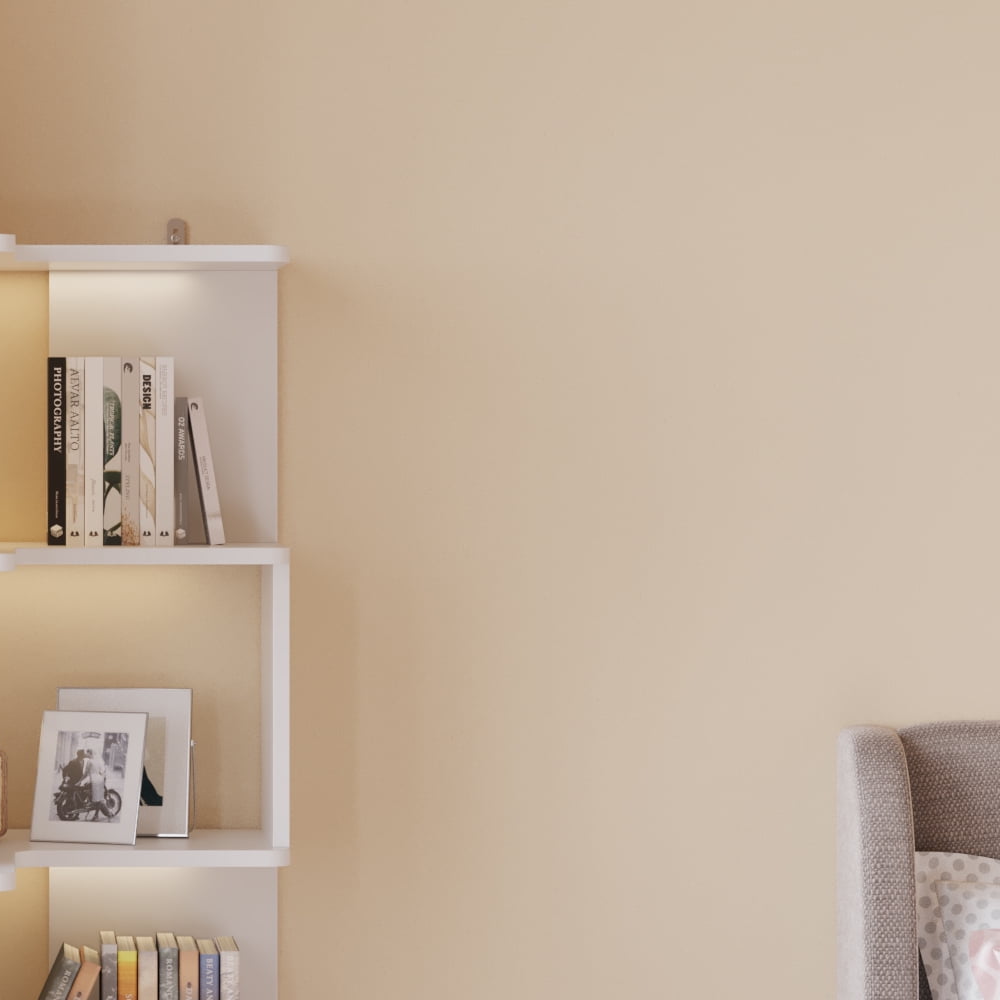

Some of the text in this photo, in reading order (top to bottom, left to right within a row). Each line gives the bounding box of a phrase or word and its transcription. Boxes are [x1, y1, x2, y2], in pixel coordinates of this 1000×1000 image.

[53, 367, 62, 453] PHOTOGRAPHY
[70, 368, 79, 451] ALVAR AALTO
[142, 374, 152, 410] DESIGN
